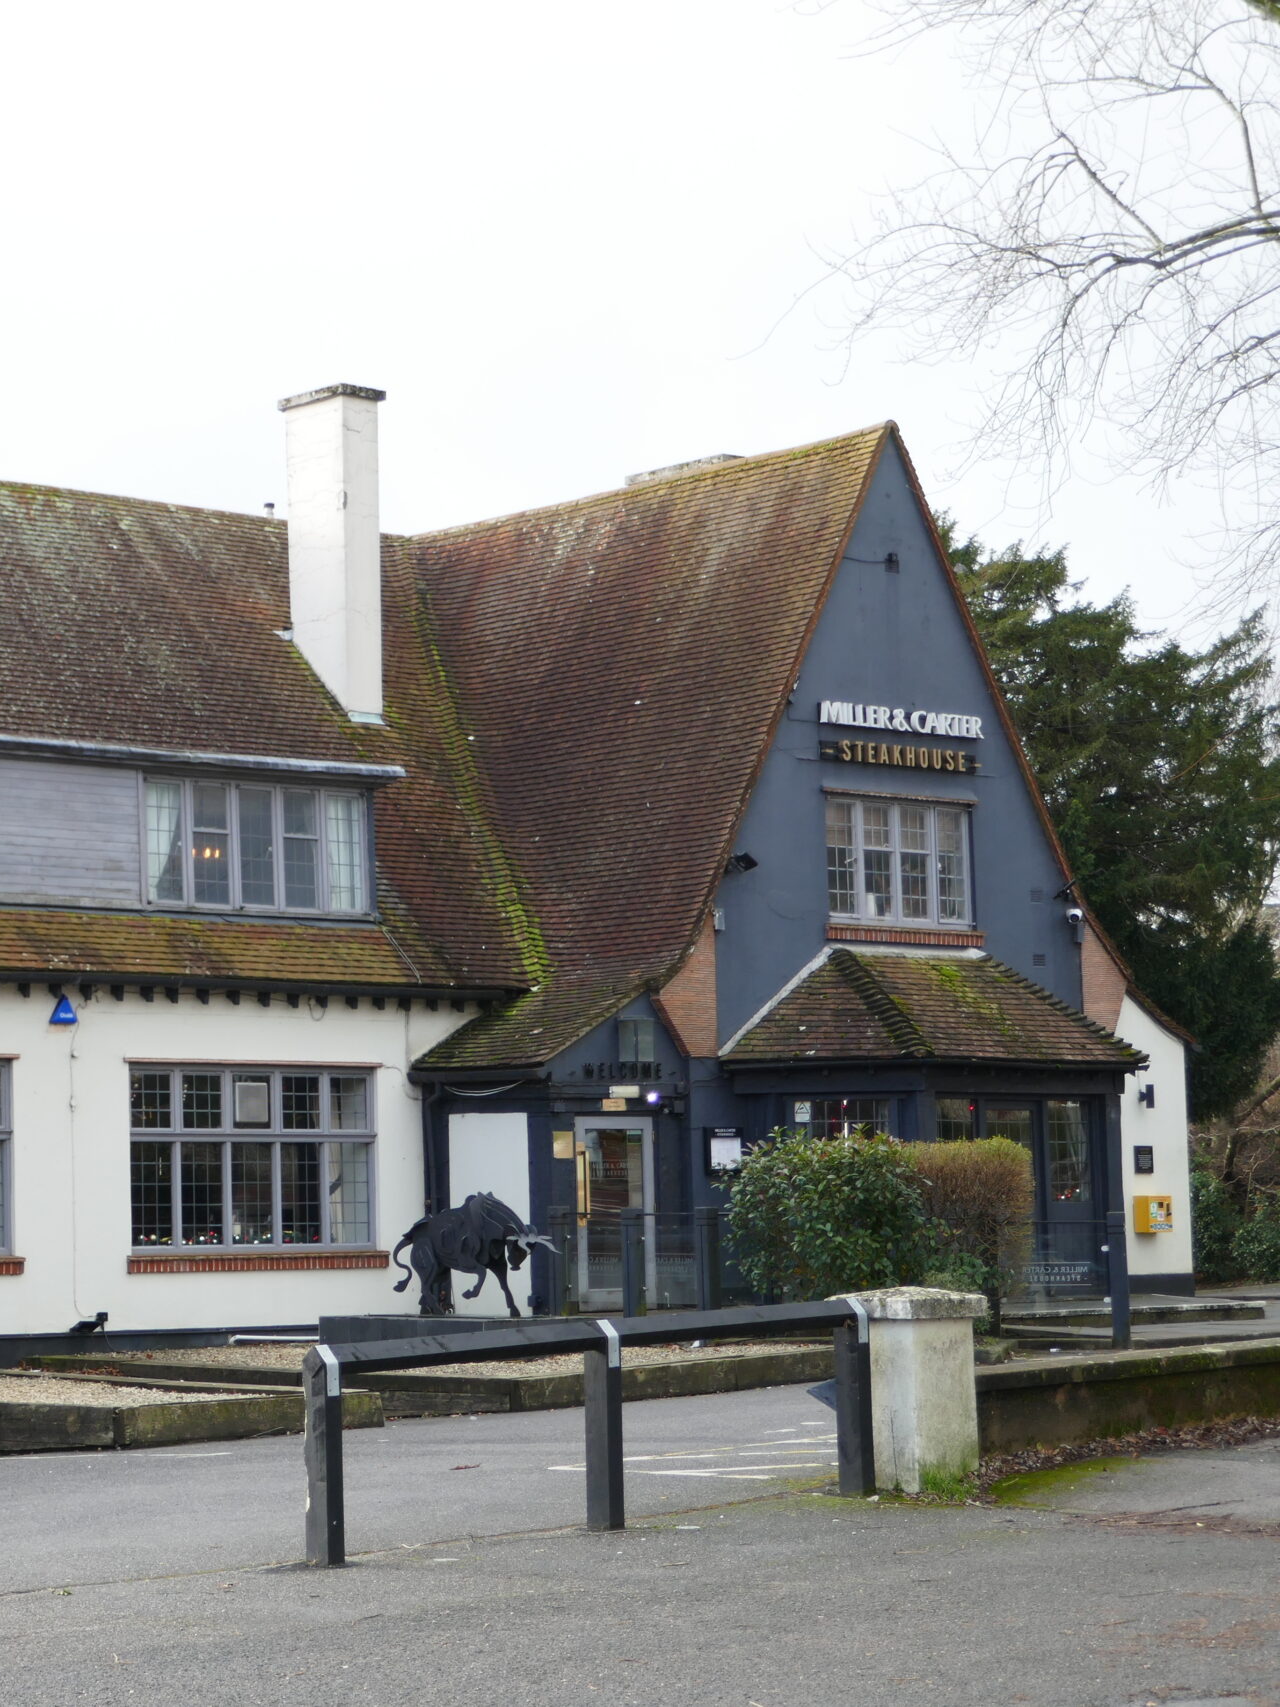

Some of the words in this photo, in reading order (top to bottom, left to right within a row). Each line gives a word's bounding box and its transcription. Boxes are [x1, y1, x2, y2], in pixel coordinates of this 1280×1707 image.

[820, 700, 893, 730] MILLER
[892, 708, 913, 732] &
[910, 710, 985, 740] CARTER
[841, 740, 967, 772] STEAKHOUSE
[582, 1063, 662, 1079] WELCOME
